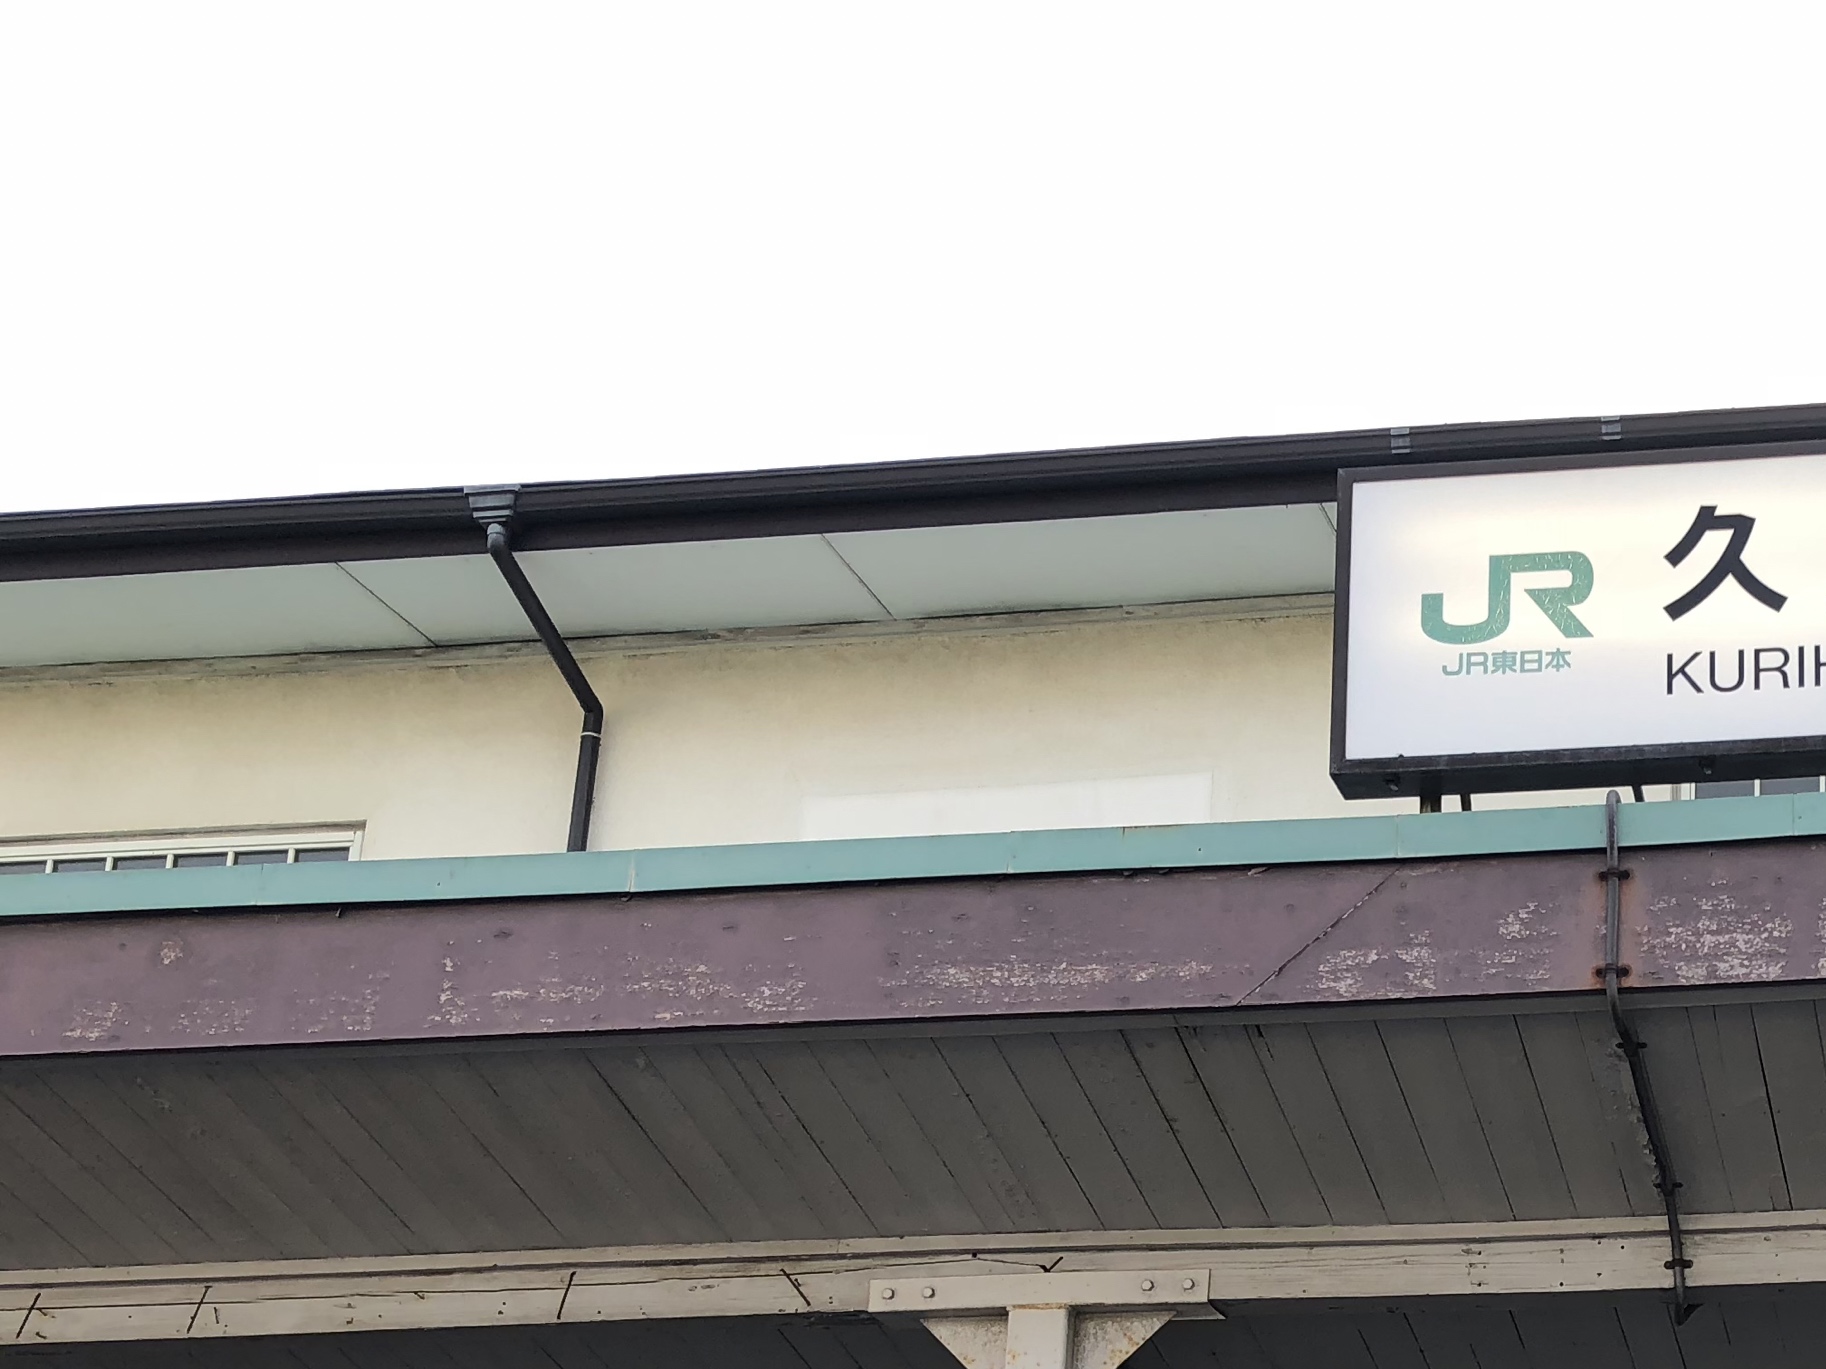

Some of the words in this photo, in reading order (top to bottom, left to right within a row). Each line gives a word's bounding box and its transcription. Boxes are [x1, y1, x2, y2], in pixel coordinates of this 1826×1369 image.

[1421, 553, 1595, 644] JR
[1441, 647, 1572, 677] JR東日本
